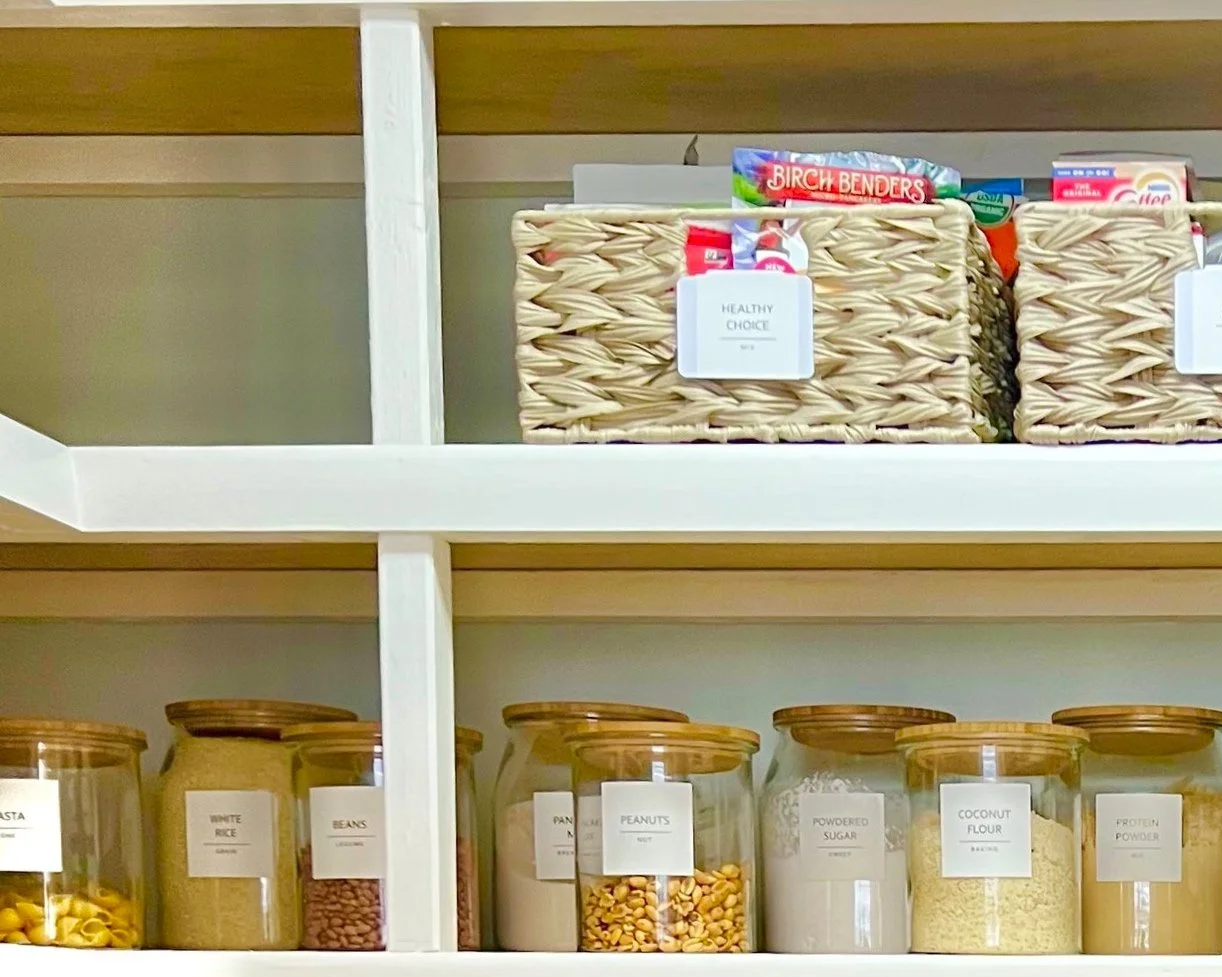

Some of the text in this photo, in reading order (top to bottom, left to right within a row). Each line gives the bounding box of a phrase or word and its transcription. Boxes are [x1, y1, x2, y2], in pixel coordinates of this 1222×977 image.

[766, 163, 833, 193] BIRCH
[838, 172, 926, 205] BENDERS
[721, 304, 775, 315] HEALTHY
[725, 320, 770, 332] CHOICE
[0, 811, 26, 822] ASTA
[209, 814, 243, 825] WHITE
[620, 815, 671, 826] PEANUTS
[957, 809, 1012, 821] COCONUT
[332, 820, 368, 831] BEANS
[812, 816, 870, 828] POWDERED
[1115, 817, 1159, 829] PROTEIN
[215, 828, 237, 839] RICE
[966, 823, 1002, 835] FLOUR
[823, 831, 858, 842] SUGAR
[1114, 832, 1160, 843] POWDER
